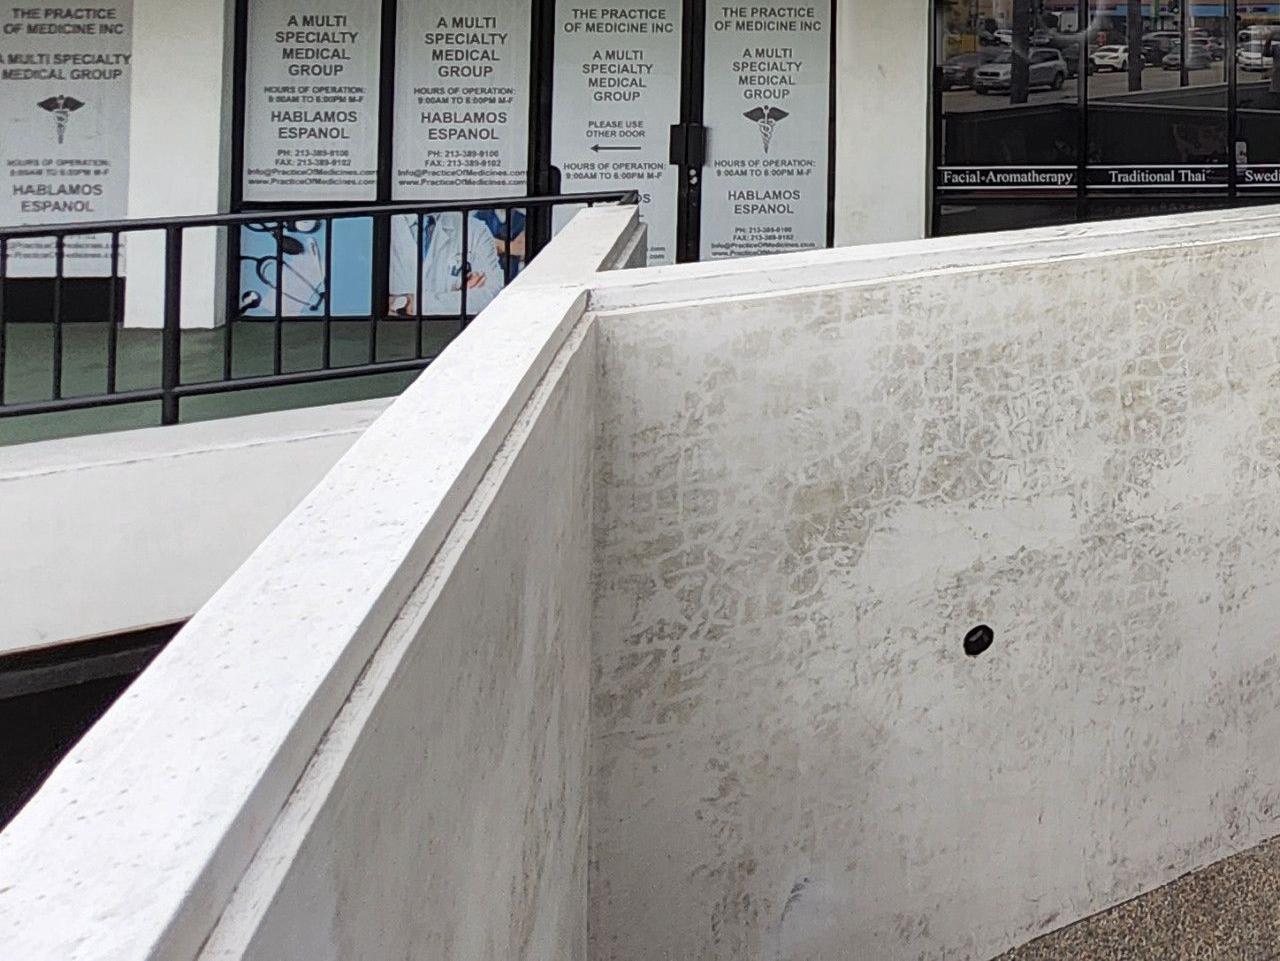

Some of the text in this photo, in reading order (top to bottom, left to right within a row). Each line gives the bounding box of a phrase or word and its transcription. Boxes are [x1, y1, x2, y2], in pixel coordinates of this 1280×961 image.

[12, 8, 116, 19] THE PRACTICE
[572, 9, 666, 19] THE PRACTICE
[722, 7, 814, 18] THE PRACTICE
[287, 15, 347, 27] A MULTI
[437, 17, 497, 28] A MULTI
[714, 21, 822, 31] OF MEDICINE INC
[564, 23, 673, 33] OF MEDICINE INC
[275, 31, 359, 43] SPECIALTY
[424, 33, 508, 45] SPECIALTY
[282, 48, 351, 59] MEDICAL
[432, 49, 501, 61] MEDICAL
[593, 50, 643, 60] A MULTI
[742, 48, 793, 58] A MULTI
[288, 64, 343, 76] GROUP
[438, 66, 493, 77] GROUP
[582, 64, 653, 74] SPECIALTY
[732, 61, 802, 72] SPECIALTY
[2, 69, 122, 79] MEDICAL GROUP
[588, 78, 647, 88] MEDICAL
[738, 75, 796, 85] MEDICAL
[414, 87, 445, 95] HOURS
[447, 87, 459, 95] OF
[593, 91, 641, 101] GROUP
[744, 89, 790, 99] GROUP
[271, 111, 358, 123] HABLAMOS
[421, 112, 508, 124] HABLAMOS
[588, 120, 644, 128] PLEASE USE
[278, 127, 350, 139] ESPANOL
[428, 128, 499, 140] ESPANOL
[586, 130, 646, 138] OTHER DOOR
[714, 159, 746, 167] HOURS
[748, 159, 760, 167] OF
[750, 169, 762, 177] TO
[1108, 169, 1206, 183] Traditional Thai
[12, 184, 103, 195] HABLAMOS
[728, 190, 801, 201] HABLAMOS
[21, 201, 95, 212] ESPANOL
[734, 204, 794, 214] ESPANOL
